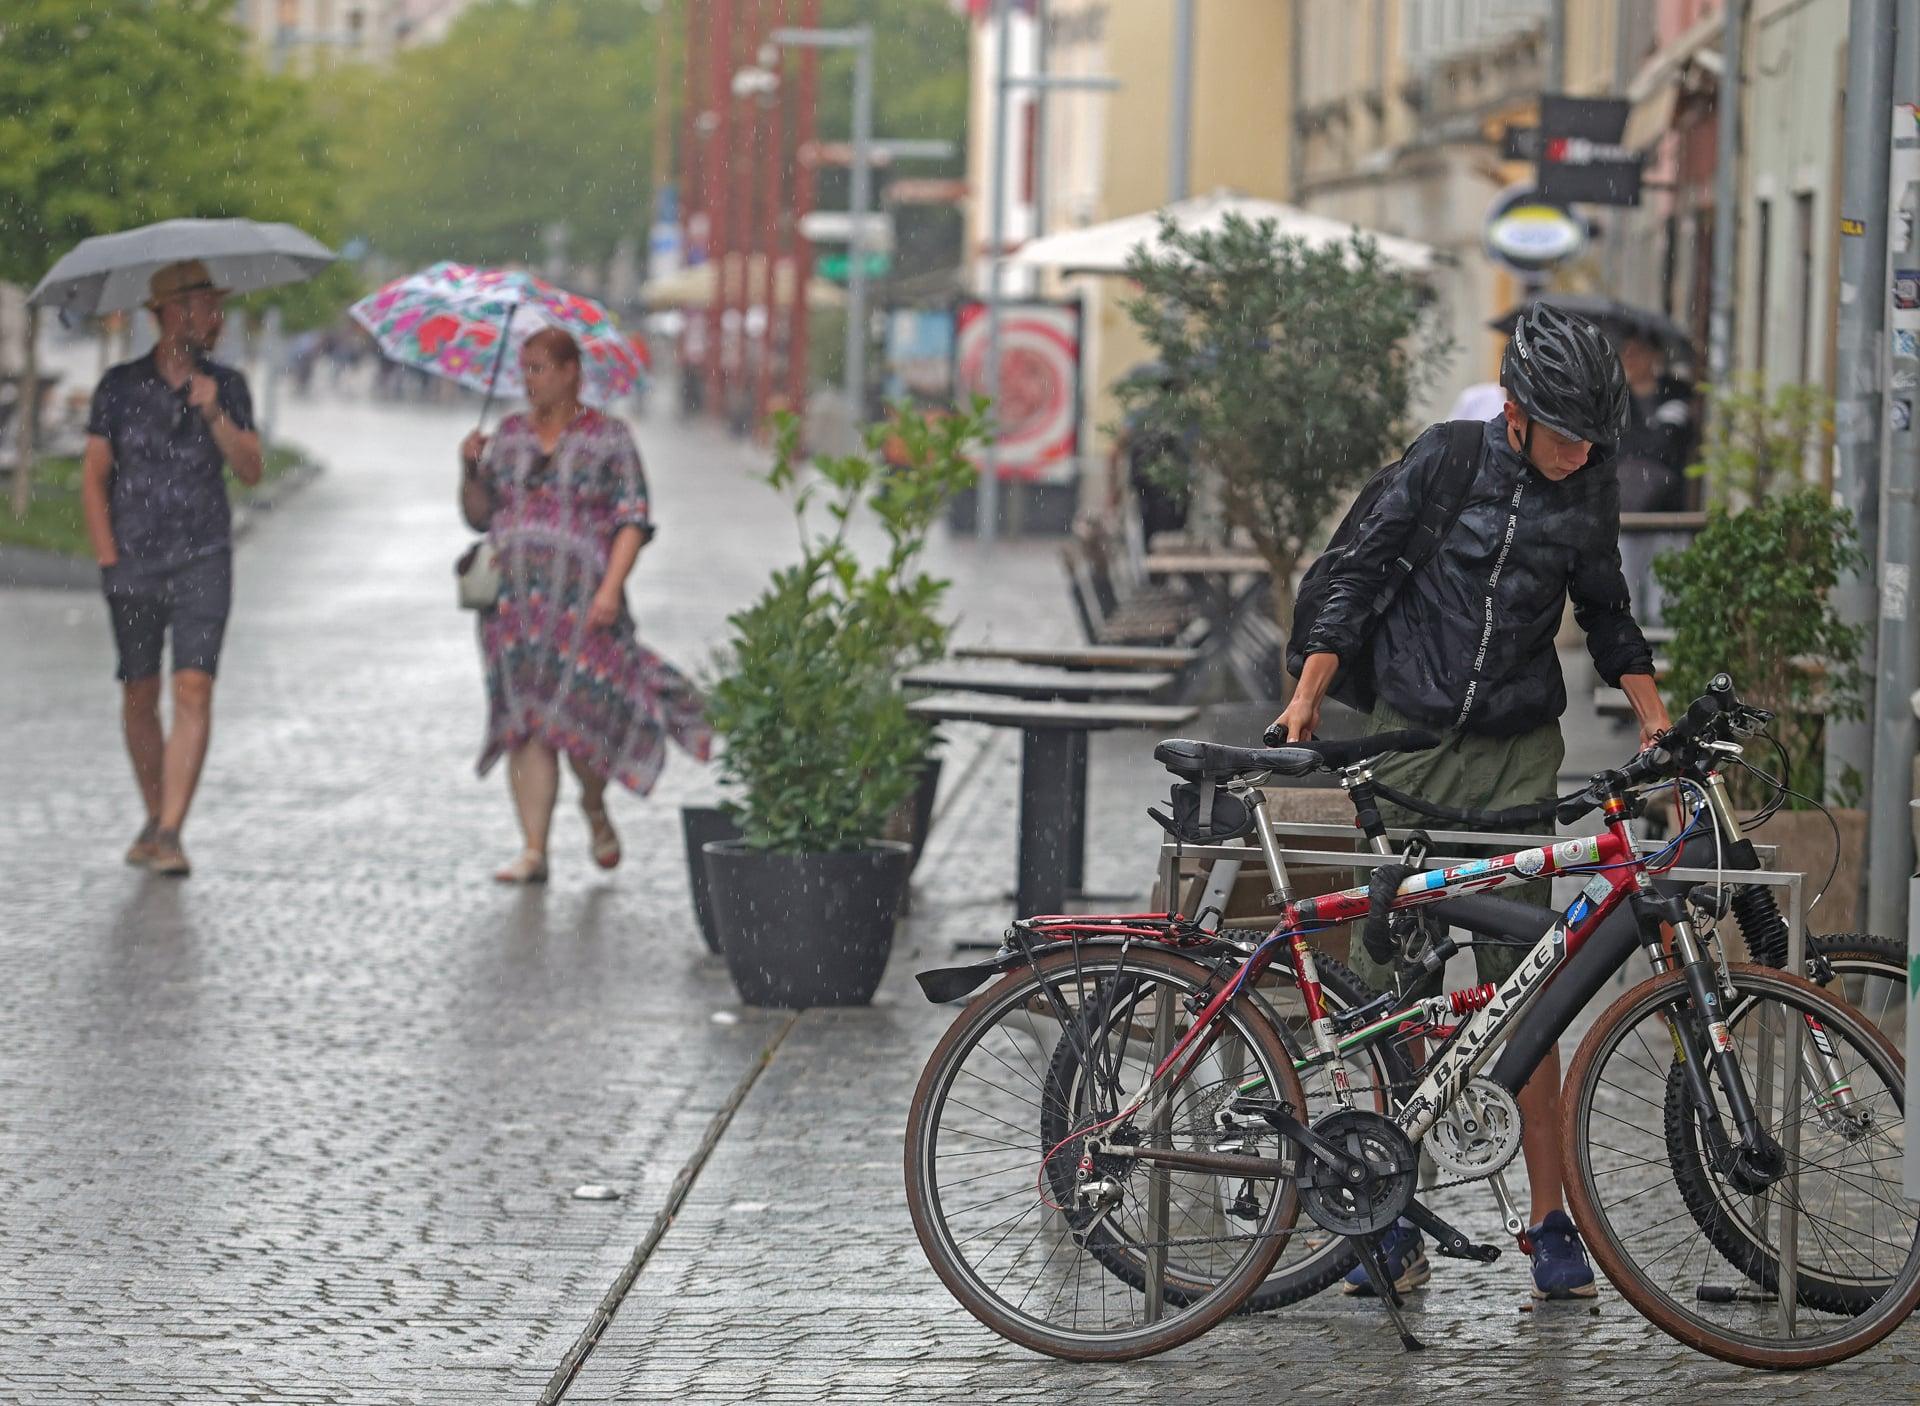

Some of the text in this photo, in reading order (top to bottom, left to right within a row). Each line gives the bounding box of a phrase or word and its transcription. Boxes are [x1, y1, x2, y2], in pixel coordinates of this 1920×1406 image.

[1512, 484, 1524, 508] STREET
[1508, 514, 1517, 528] NYC
[1489, 565, 1502, 588] STREET
[1485, 596, 1493, 610] NYC
[1480, 622, 1492, 647] URBAN
[1474, 647, 1486, 672] STREET
[1467, 680, 1477, 696] NYC
[1463, 695, 1473, 712] KIDS
[1433, 945, 1551, 1088] BALANCE
